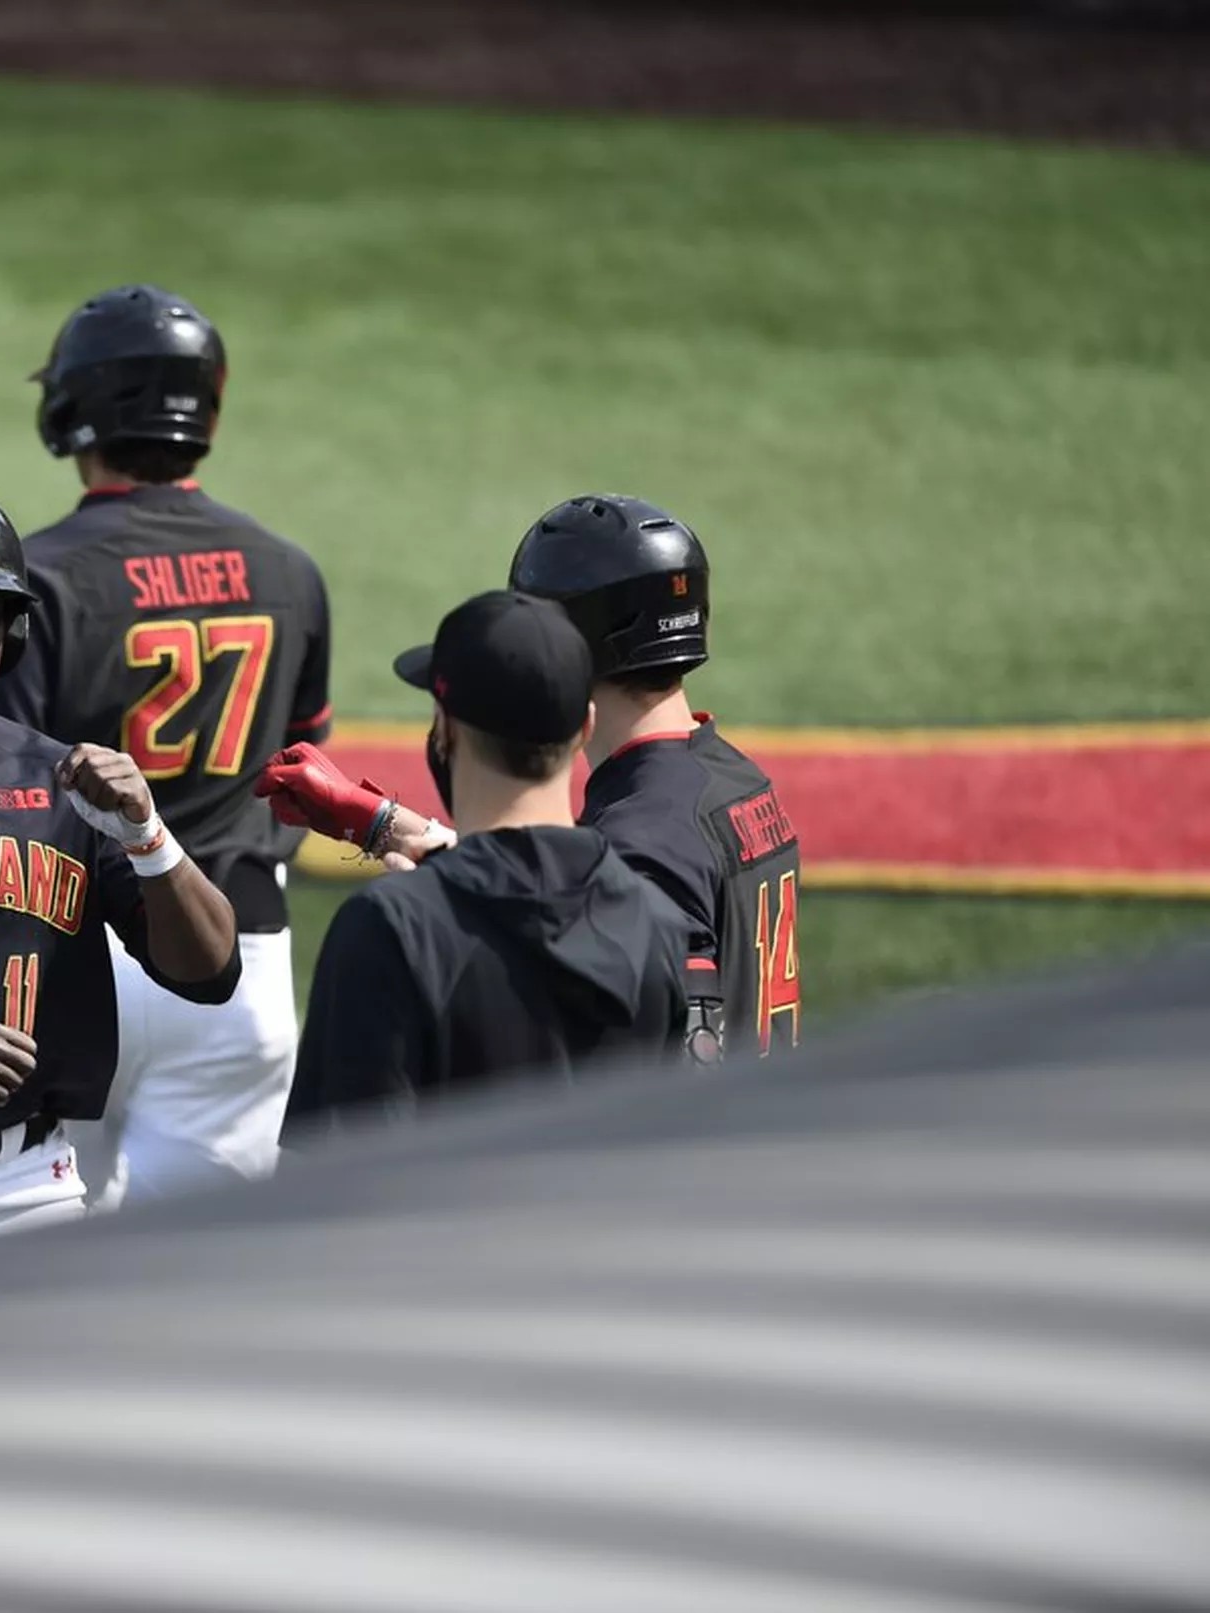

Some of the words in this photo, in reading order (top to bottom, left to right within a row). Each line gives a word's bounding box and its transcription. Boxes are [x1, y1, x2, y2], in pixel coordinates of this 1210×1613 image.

[124, 550, 251, 608] SHLIGER
[121, 615, 274, 780] 27
[3, 953, 39, 1037] 11
[755, 870, 800, 1058] 14
